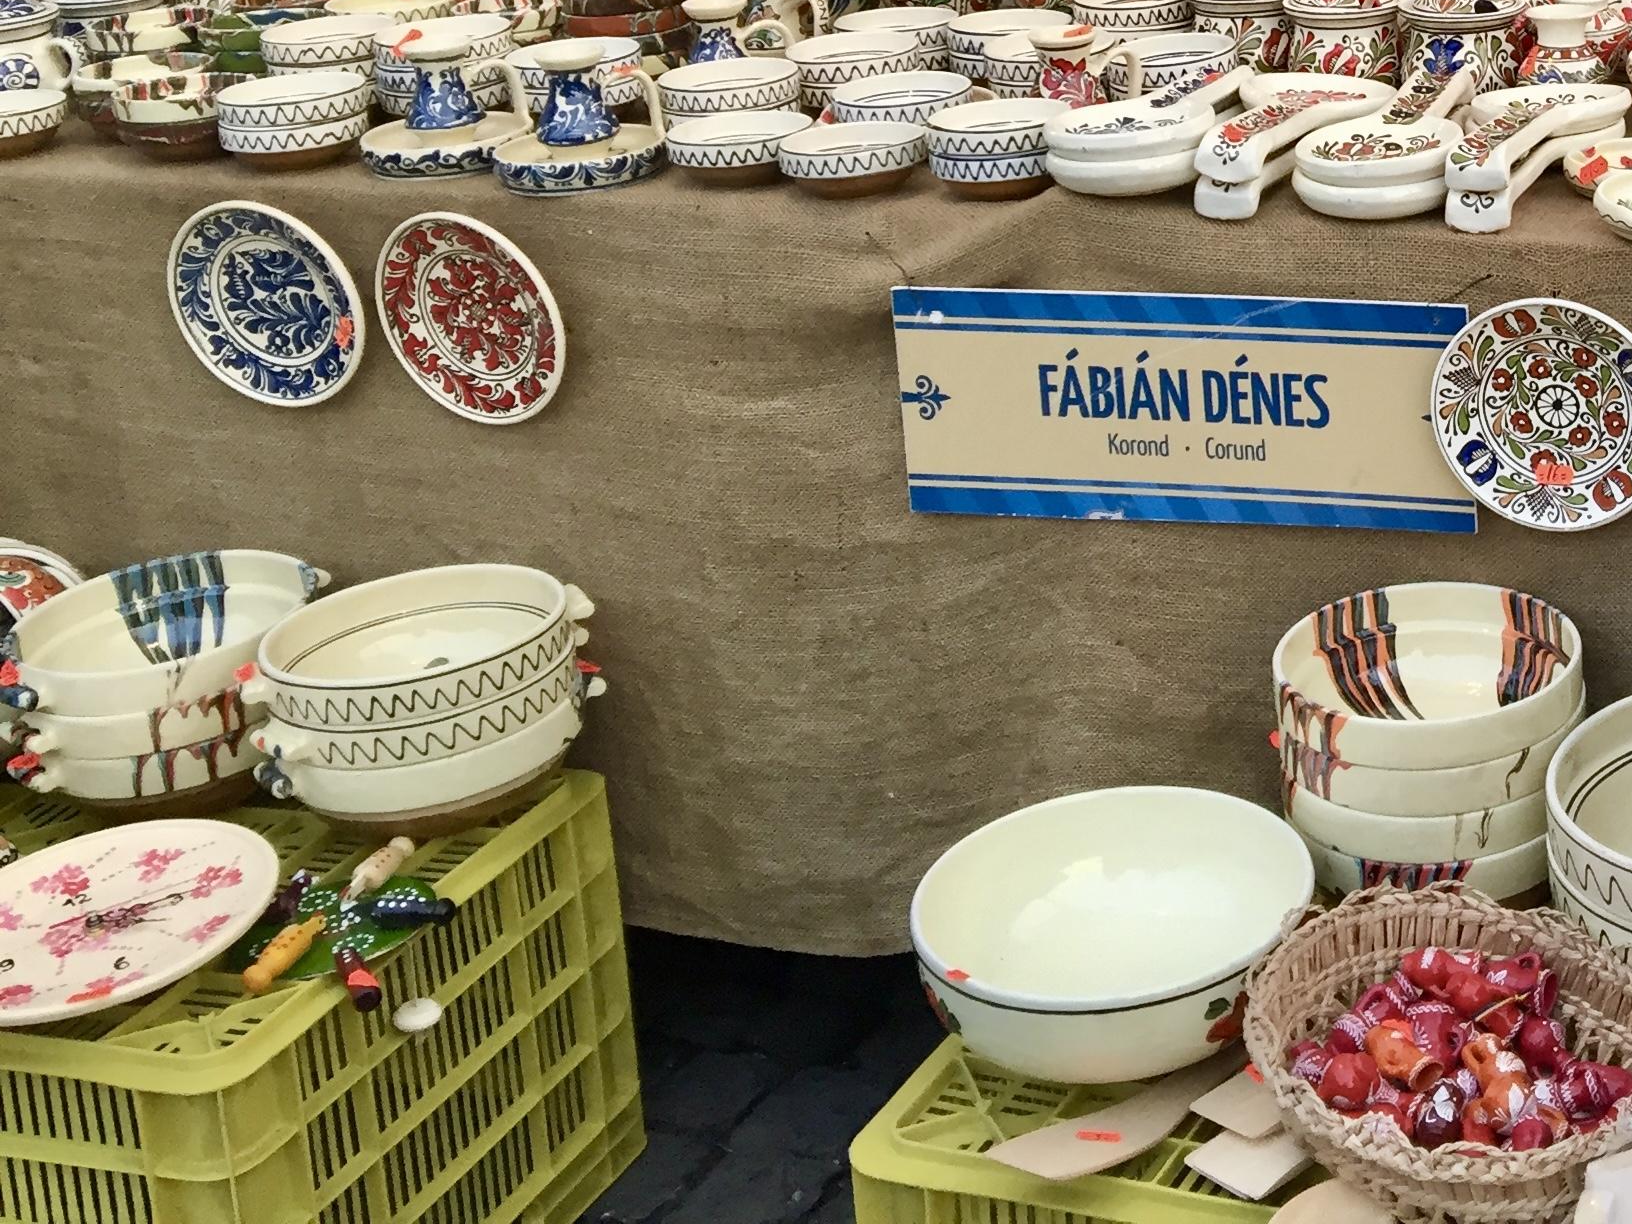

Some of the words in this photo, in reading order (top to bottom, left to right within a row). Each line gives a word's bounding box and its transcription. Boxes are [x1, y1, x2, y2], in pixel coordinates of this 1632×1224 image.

[1038, 347, 1190, 423] FÁBIÁN
[1202, 353, 1331, 428] DÉNES
[1107, 433, 1170, 458] Korond
[1205, 437, 1267, 462] Corund
[113, 956, 130, 971] 6
